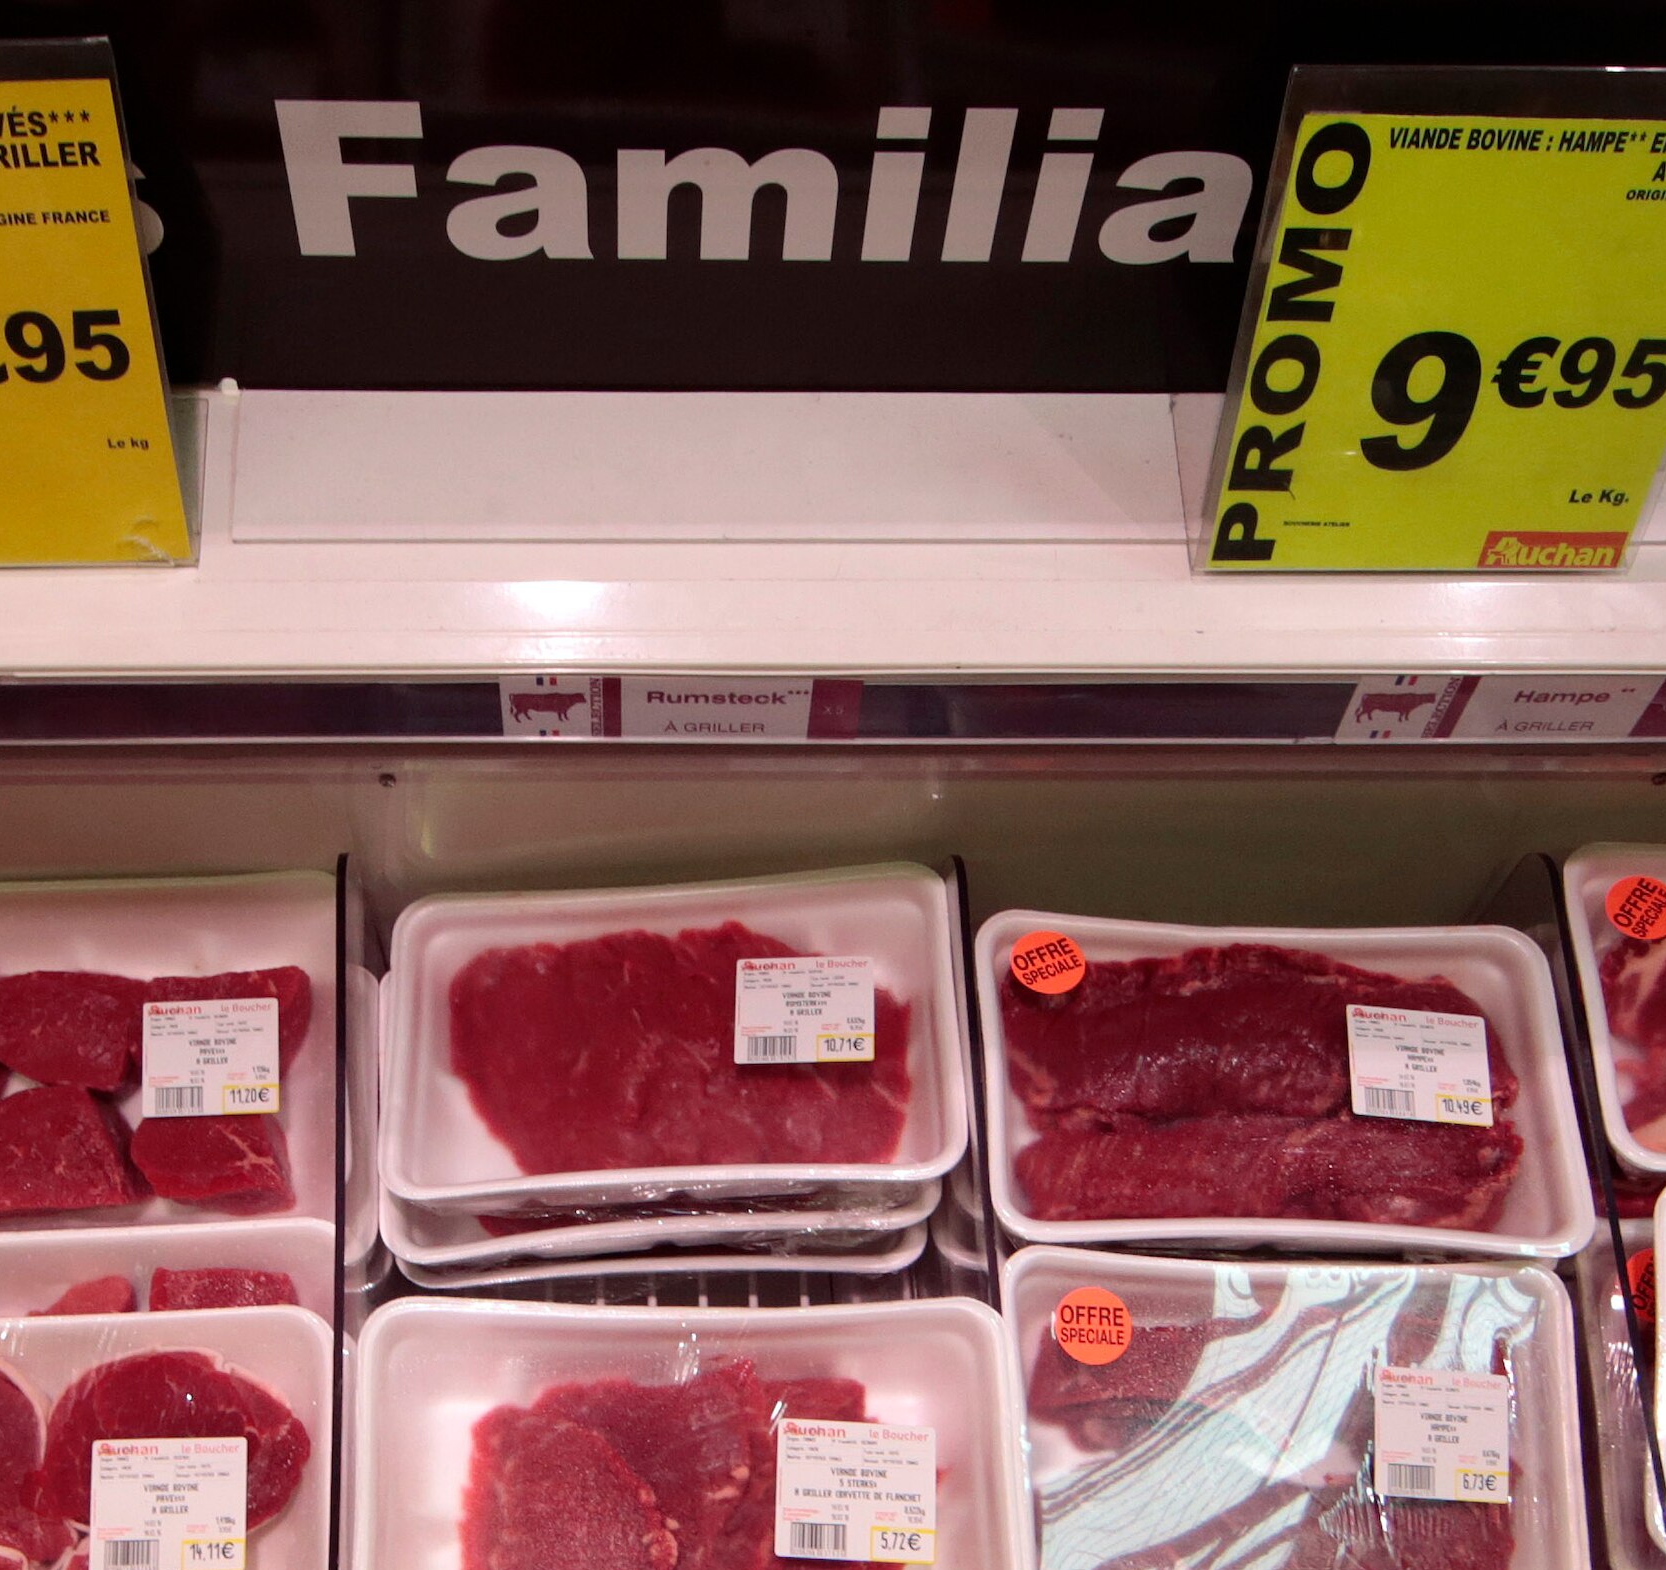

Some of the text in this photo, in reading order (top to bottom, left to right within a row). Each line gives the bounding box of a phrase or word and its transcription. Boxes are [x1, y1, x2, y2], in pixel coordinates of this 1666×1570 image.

[1388, 126, 1462, 151] VIANDE
[1465, 127, 1543, 152] BOVINE
[41, 209, 111, 225] FRANCE
[1211, 121, 1372, 561] PROMO
[107, 436, 127, 450] Le
[1568, 489, 1594, 504] Le
[1484, 535, 1616, 568] Auchan
[1513, 689, 1611, 706] Hampe
[664, 720, 766, 734] À GRILLER
[1495, 720, 1594, 733] À GRILLER
[1613, 877, 1658, 930] OFFRE
[1013, 937, 1076, 972] OFFRE
[1022, 955, 1083, 986] SPECIALE
[824, 1037, 865, 1053] 10,71€
[230, 1088, 269, 1104] 11,20€
[1442, 1098, 1483, 1115] 10,49€
[1061, 1305, 1125, 1327] OFFRE
[1061, 1327, 1126, 1346] SPECIALE
[783, 1421, 929, 1442] Auchan le Boucher
[97, 1443, 240, 1455] Auchan le Boucher
[1462, 1473, 1497, 1491] 6,73€
[881, 1531, 922, 1551] 5,72€
[190, 1543, 235, 1560] 14,11€
